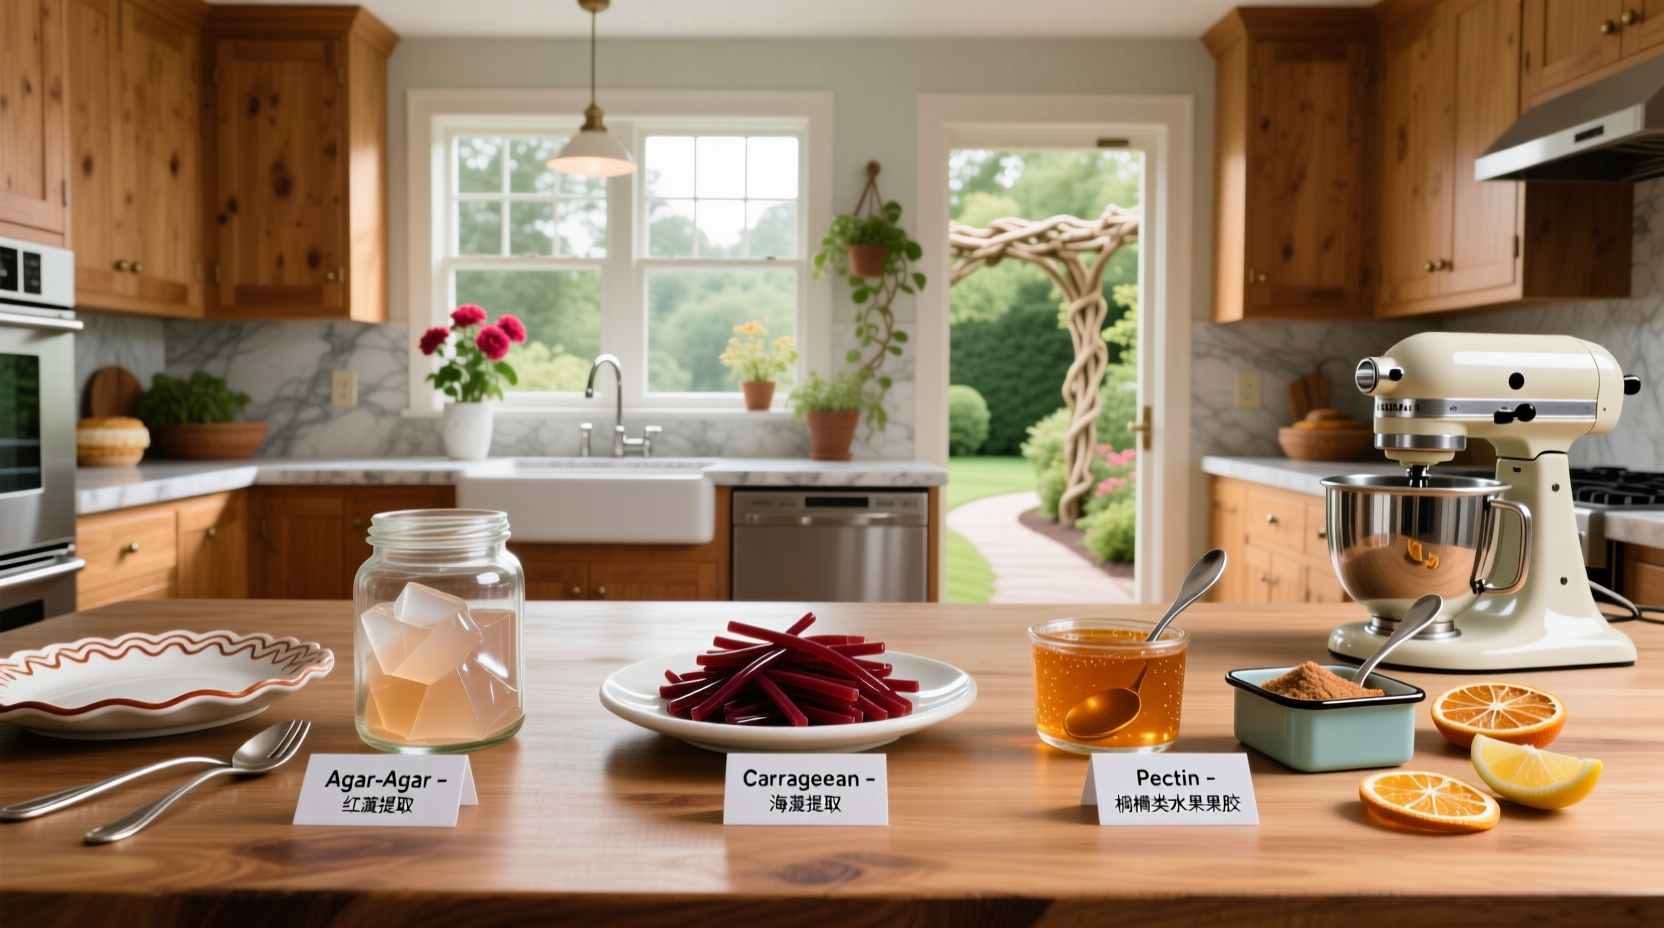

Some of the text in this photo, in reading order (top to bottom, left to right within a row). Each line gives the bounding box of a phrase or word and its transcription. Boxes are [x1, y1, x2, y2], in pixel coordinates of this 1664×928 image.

[324, 770, 432, 793] Agar-Agar
[743, 769, 859, 791] Carrageean
[1136, 769, 1200, 786] Pectin
